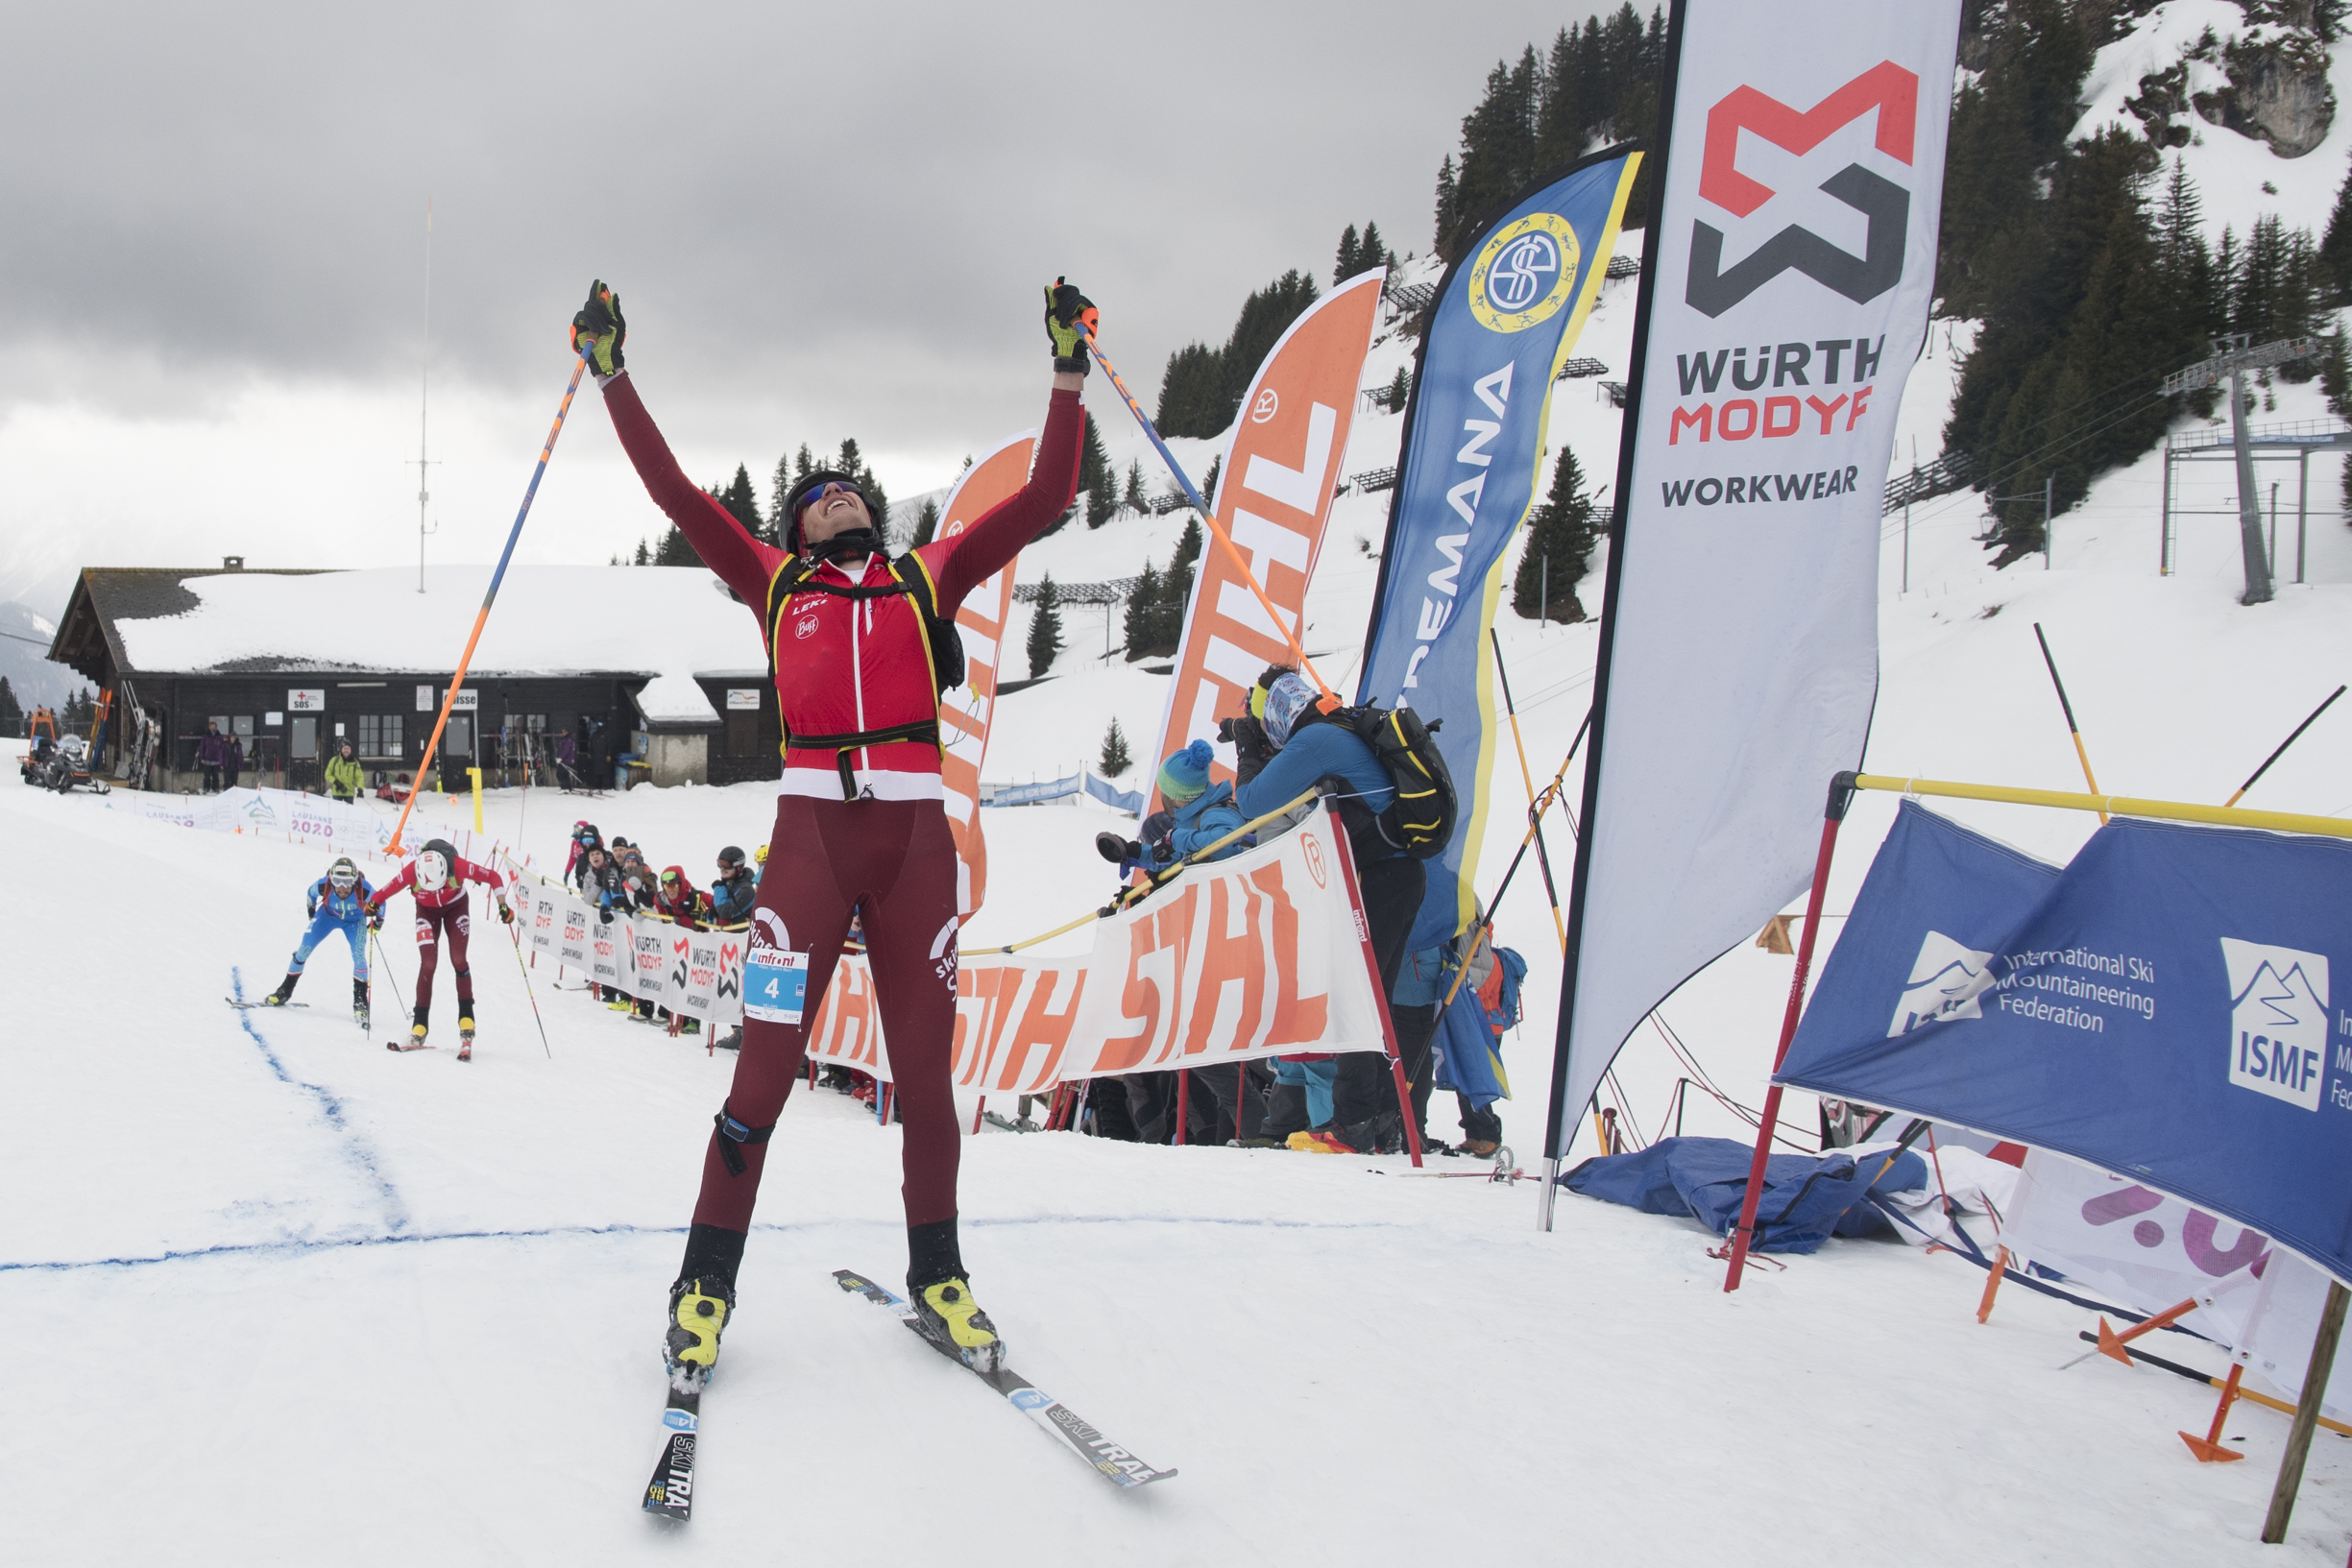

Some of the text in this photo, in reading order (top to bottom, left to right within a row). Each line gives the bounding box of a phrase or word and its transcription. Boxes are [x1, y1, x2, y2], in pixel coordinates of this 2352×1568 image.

[1676, 334, 1886, 397] WÜRTH
[1668, 386, 1874, 446] MODYF
[1661, 465, 1859, 508] WORKWEAR
[294, 700, 309, 709] SOS
[292, 810, 333, 824] LAUSANNE
[292, 819, 333, 837] 2020
[566, 909, 586, 929] ÜRTH
[564, 926, 585, 942] ODYF
[692, 947, 717, 969] WÜRTH
[2003, 947, 2154, 983] International Ski
[690, 967, 715, 987] MODYF
[764, 977, 780, 999] 4
[1996, 973, 2154, 1020] Mountaineering
[1999, 993, 2103, 1032] Federation
[2240, 1030, 2319, 1093] ISMF
